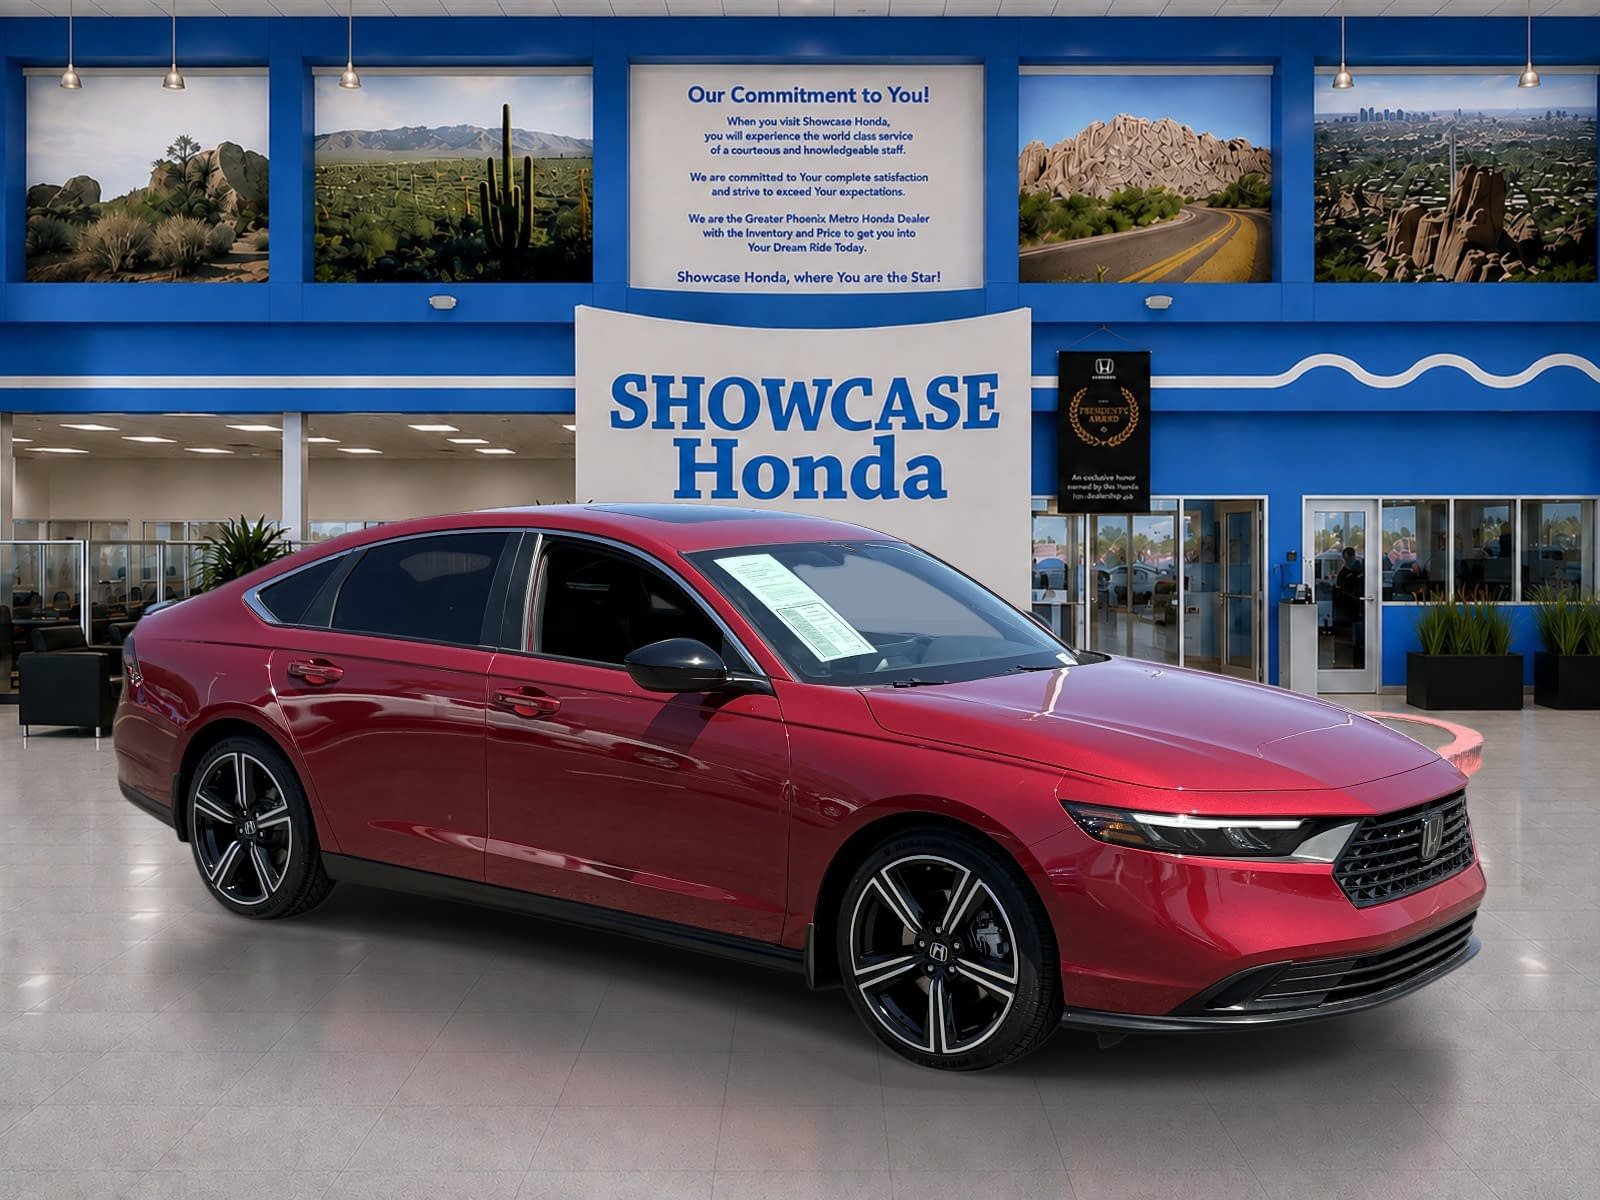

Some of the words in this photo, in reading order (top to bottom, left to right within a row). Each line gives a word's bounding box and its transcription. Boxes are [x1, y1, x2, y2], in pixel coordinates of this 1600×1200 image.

[687, 85, 726, 104] Our
[730, 85, 857, 104] Commitment
[861, 87, 883, 104] to
[886, 85, 930, 104] You!
[726, 116, 757, 127] When
[758, 118, 778, 129] you
[779, 116, 801, 127] visit
[802, 116, 853, 127] Showcase
[854, 116, 891, 128] Honda,
[704, 133, 724, 144] you
[725, 130, 744, 141] will
[745, 130, 801, 144] experience
[802, 130, 820, 141] the
[821, 130, 851, 141] world
[852, 130, 877, 141] class
[878, 130, 914, 141] service
[710, 144, 721, 155] of
[722, 147, 730, 155] a
[730, 146, 781, 156] courteous
[782, 144, 802, 155] and
[881, 144, 906, 155] staff.
[689, 172, 708, 183] We
[709, 174, 726, 182] are
[728, 171, 784, 183] committed
[785, 173, 798, 182] to
[799, 172, 823, 183] Your
[824, 172, 872, 185] complete
[873, 171, 929, 183] satisfaction
[711, 186, 731, 197] and
[732, 186, 761, 197] strive
[762, 187, 774, 197] to
[775, 186, 812, 197] exceed
[814, 186, 838, 197] Your
[839, 186, 906, 200] expectations.
[688, 213, 706, 224] We
[707, 215, 725, 224] are
[725, 213, 743, 224] the
[744, 213, 785, 224] Greater
[785, 213, 827, 224] Phoenix
[828, 213, 860, 224] Metro
[861, 213, 895, 224] Honda
[897, 213, 931, 224] Dealer
[702, 227, 725, 238] with
[726, 227, 744, 238] the
[745, 227, 794, 241] Inventory
[795, 227, 815, 238] and
[816, 227, 842, 239] Price
[843, 229, 855, 238] to
[856, 229, 875, 241] get
[876, 230, 895, 241] you
[896, 227, 917, 238] into
[747, 242, 772, 253] Your
[773, 242, 808, 253] Dream
[809, 242, 833, 253] Ride
[834, 242, 867, 255] Today.
[677, 270, 741, 284] Showcase
[744, 270, 790, 286] Honda,
[793, 270, 834, 284] where
[836, 271, 861, 284] You
[863, 274, 884, 284] are
[886, 270, 908, 284] the
[911, 271, 941, 284] Star!
[609, 372, 1001, 432] SHOWCASE
[672, 434, 948, 501] Honda
